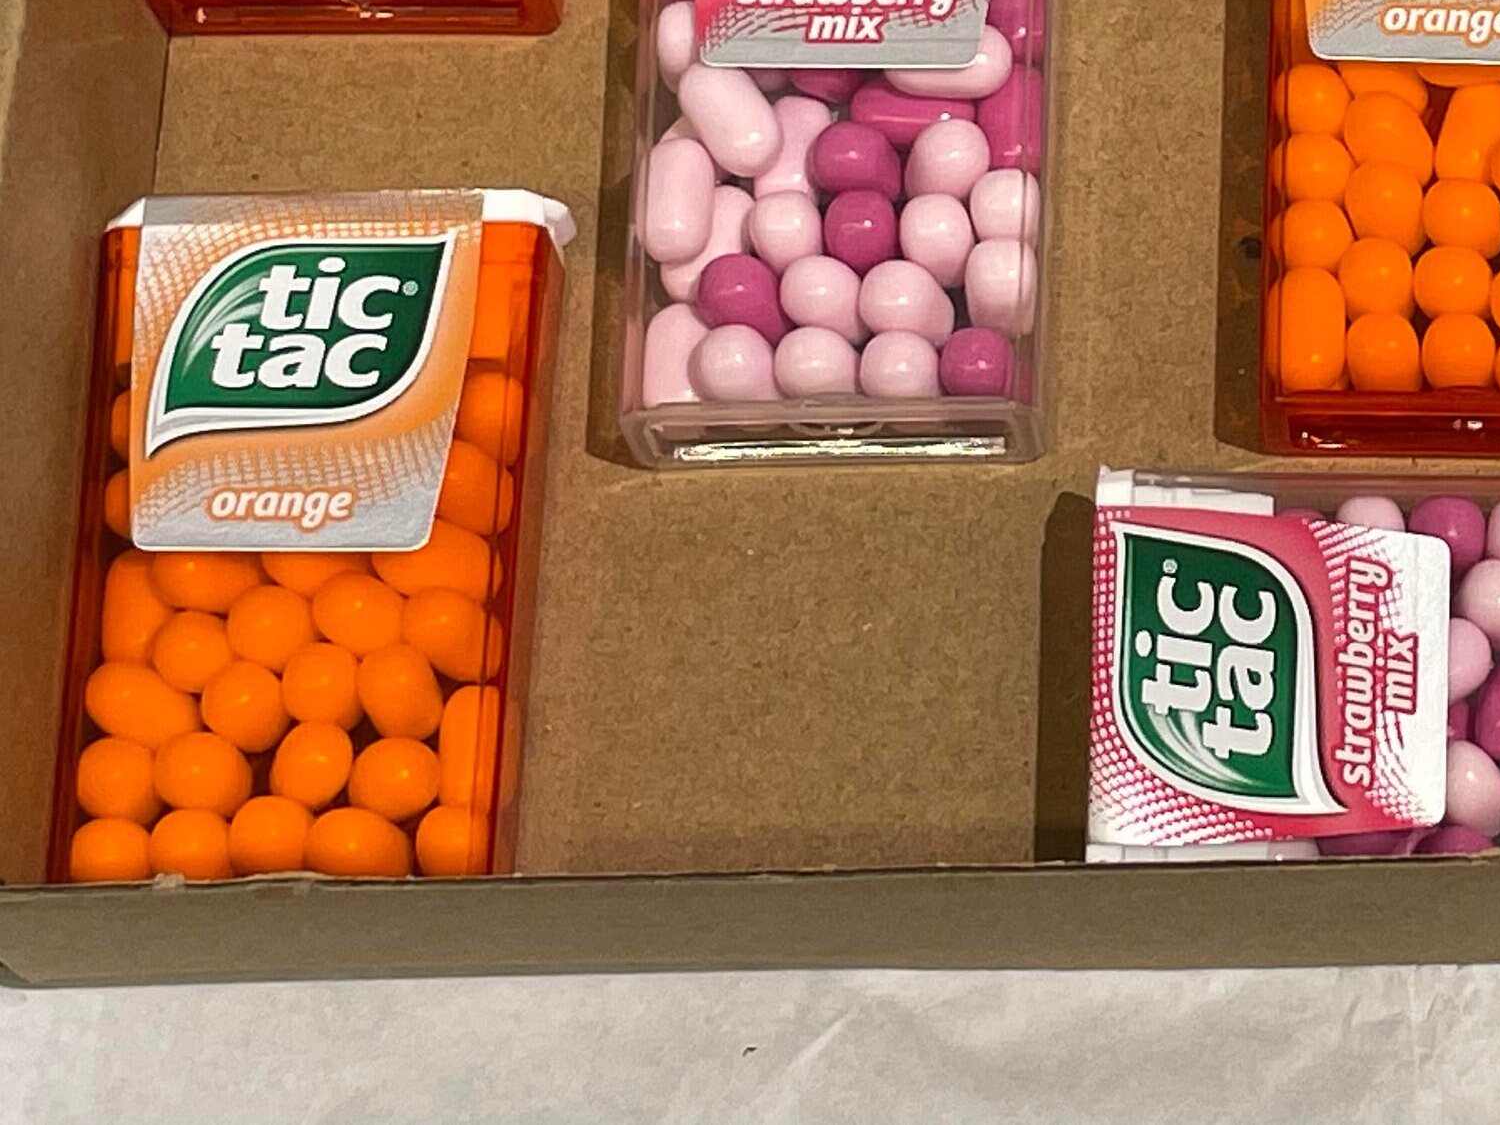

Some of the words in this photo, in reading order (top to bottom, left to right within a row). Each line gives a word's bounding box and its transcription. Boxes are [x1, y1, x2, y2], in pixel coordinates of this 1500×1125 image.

[810, 7, 881, 40] mix
[259, 257, 401, 330] tic
[211, 323, 388, 389] tac
[212, 490, 352, 527] orange
[1135, 576, 1214, 714] tic
[1203, 586, 1277, 758] tac
[1336, 561, 1388, 786] strawberry
[1375, 635, 1415, 710] mix
